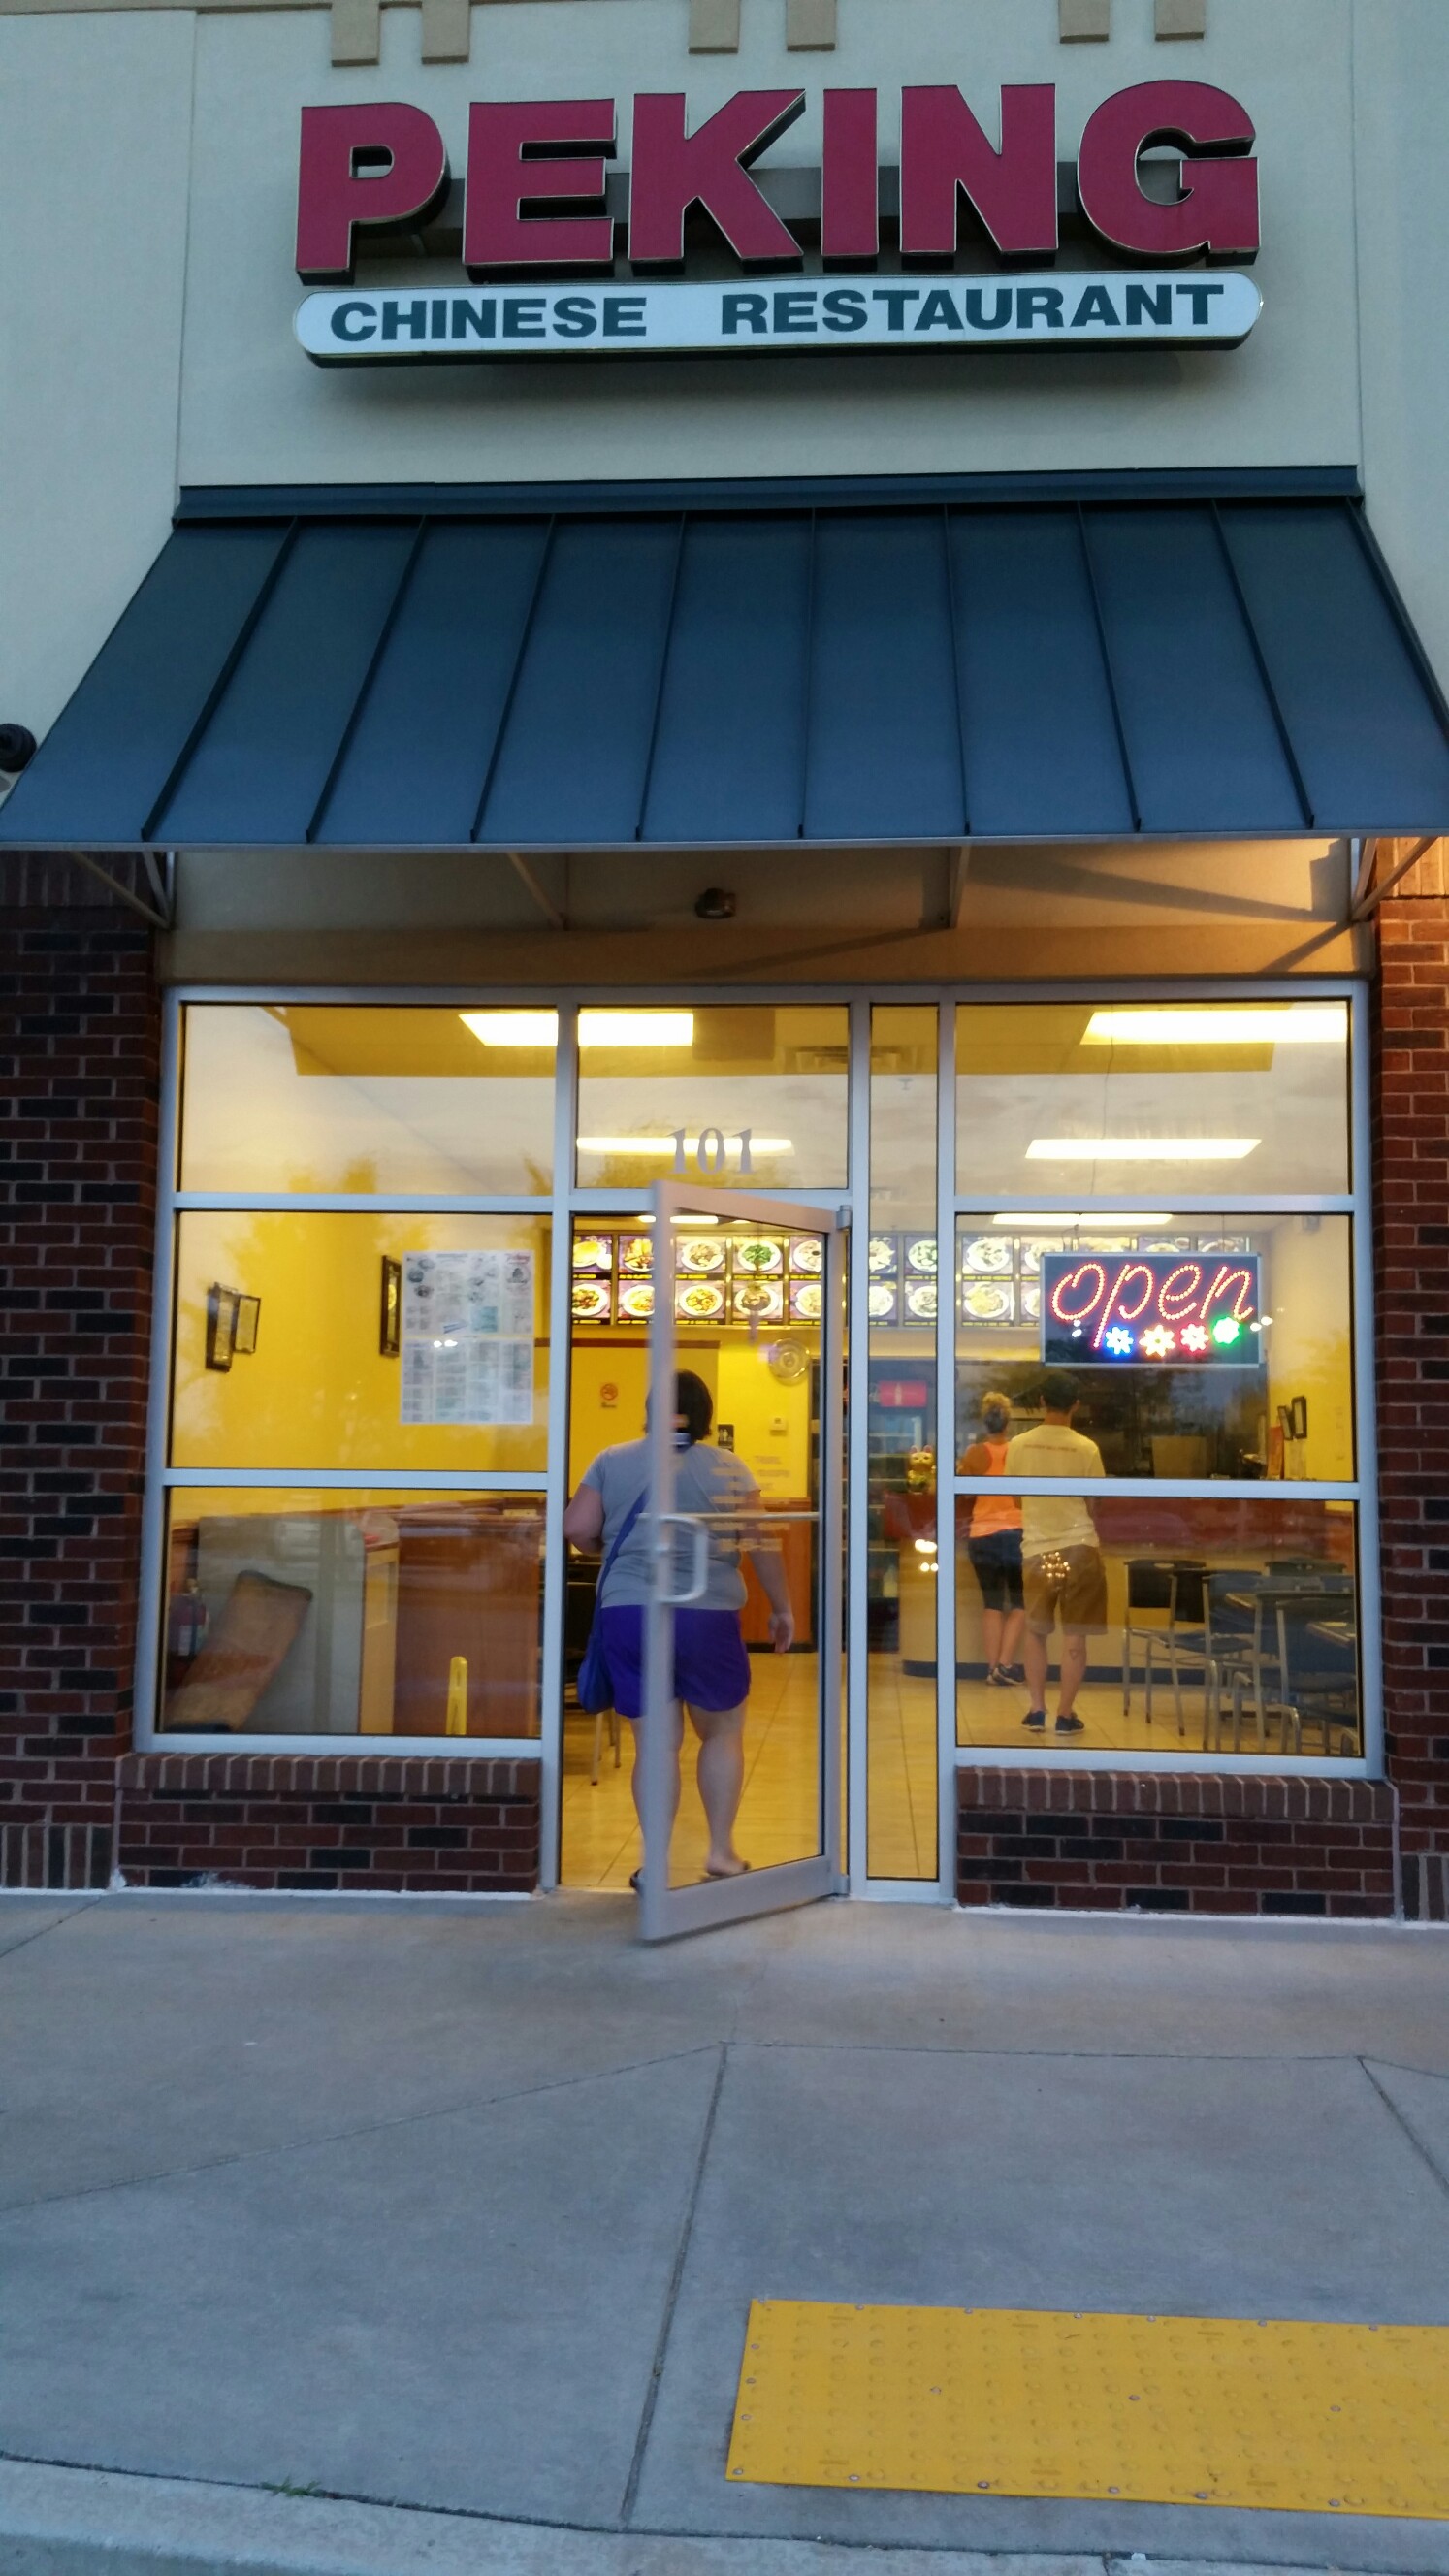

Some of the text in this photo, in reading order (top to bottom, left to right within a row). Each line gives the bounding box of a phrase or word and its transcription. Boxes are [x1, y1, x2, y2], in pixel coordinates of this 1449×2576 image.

[295, 80, 1260, 276] PEKING
[330, 283, 1225, 342] CHINESE RESTAURANT
[665, 1127, 758, 1175] 101
[1050, 1263, 1254, 1348] open
